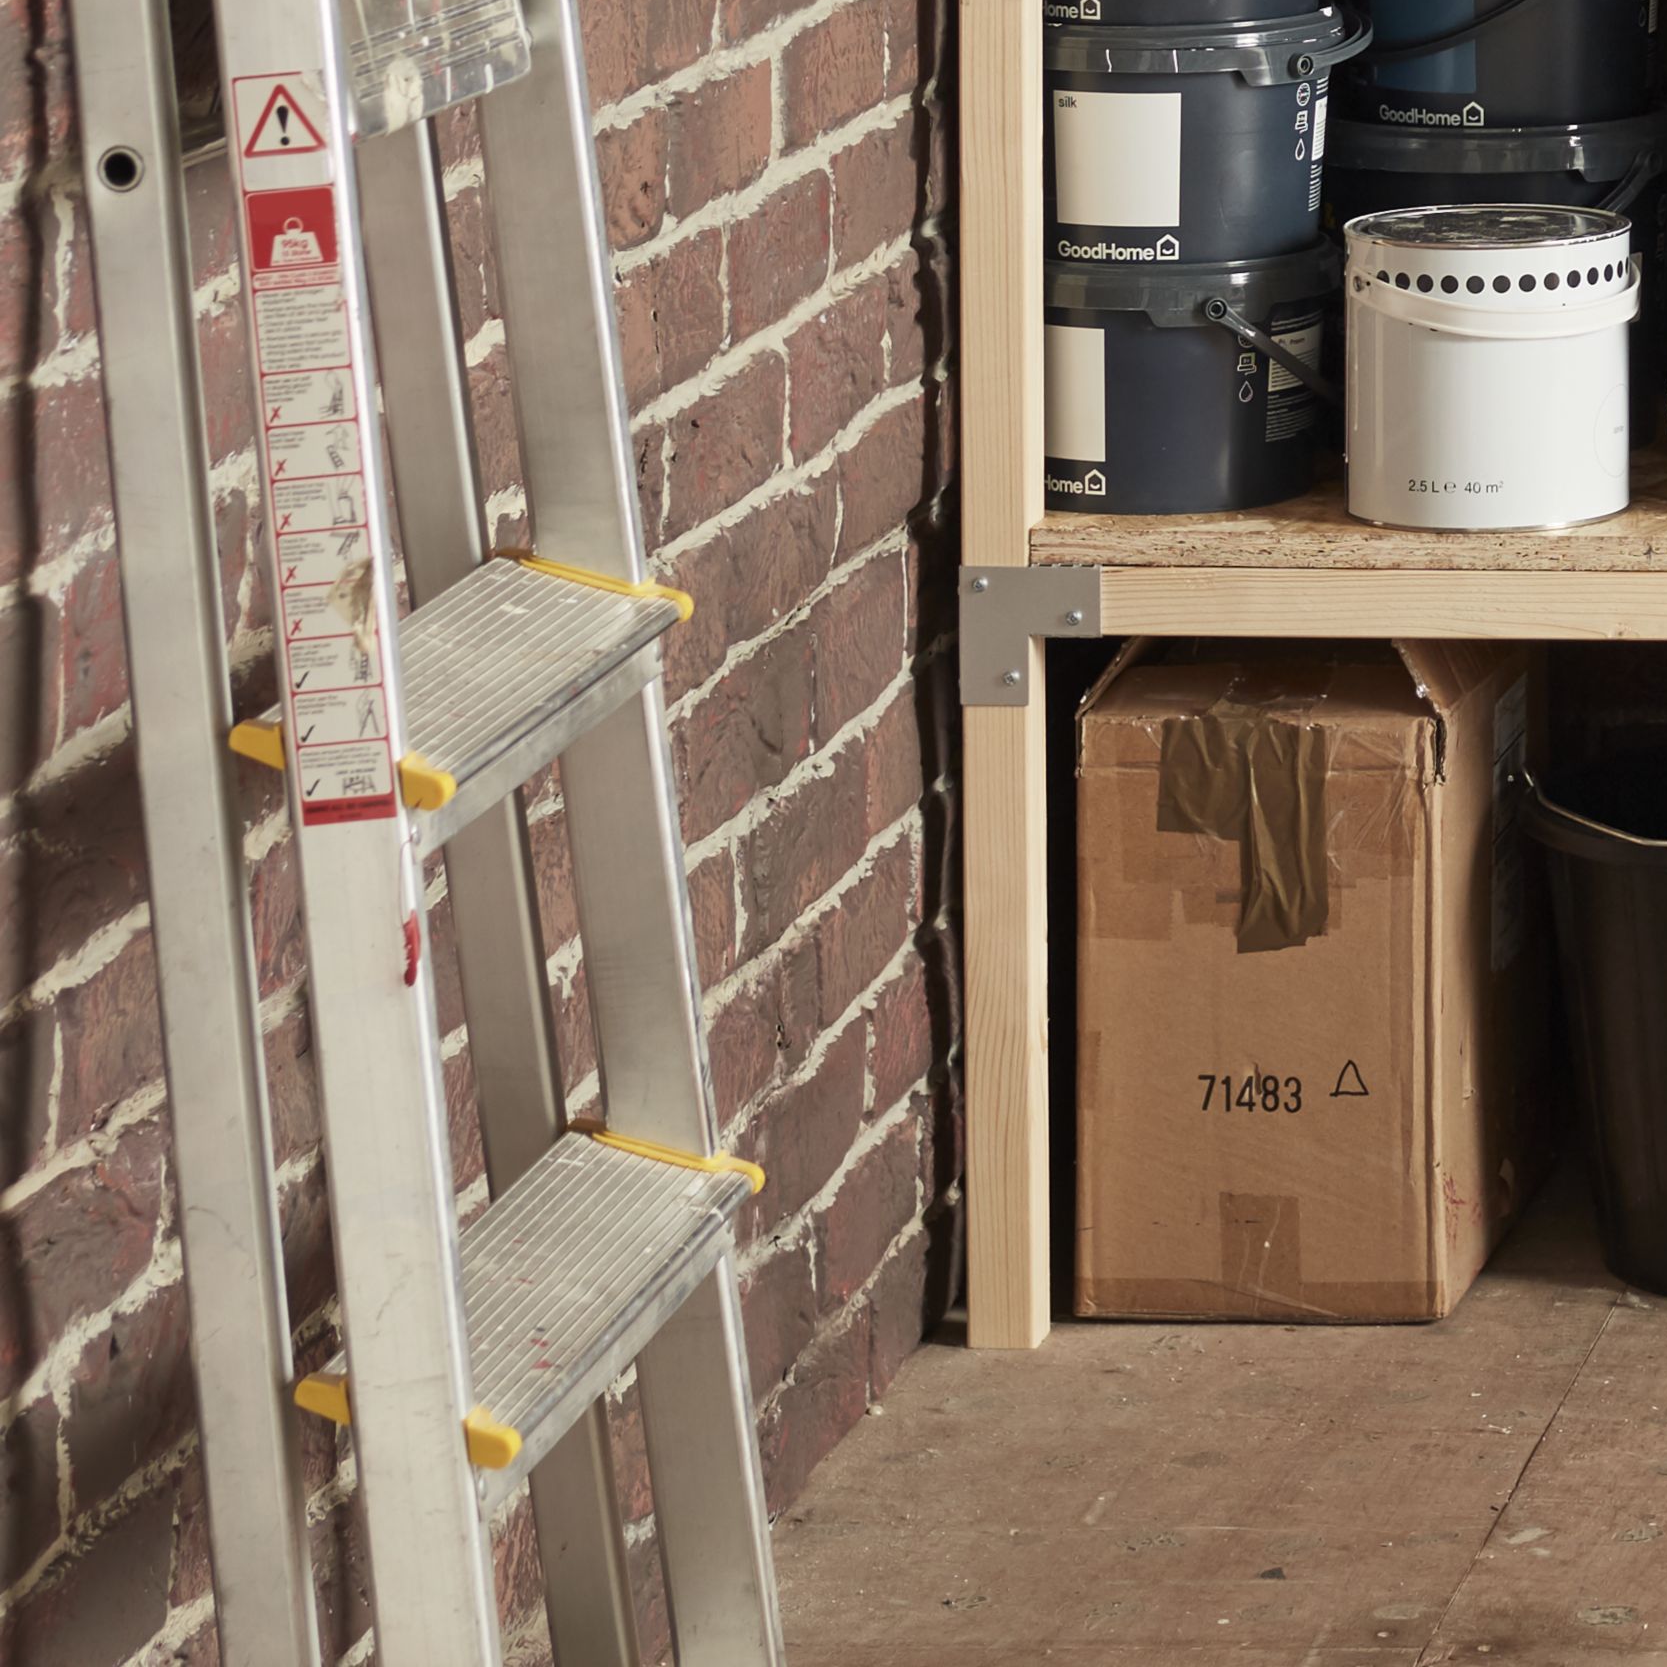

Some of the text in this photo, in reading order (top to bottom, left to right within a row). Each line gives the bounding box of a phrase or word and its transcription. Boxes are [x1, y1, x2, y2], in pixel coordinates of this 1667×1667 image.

[1058, 96, 1078, 108] silk
[1379, 104, 1462, 127] GoodHome
[1057, 240, 1155, 261] GoodHome
[1408, 479, 1428, 493] 2.5
[1432, 480, 1440, 493] L
[1464, 481, 1481, 494] 40
[1197, 1074, 1302, 1114] 71483
